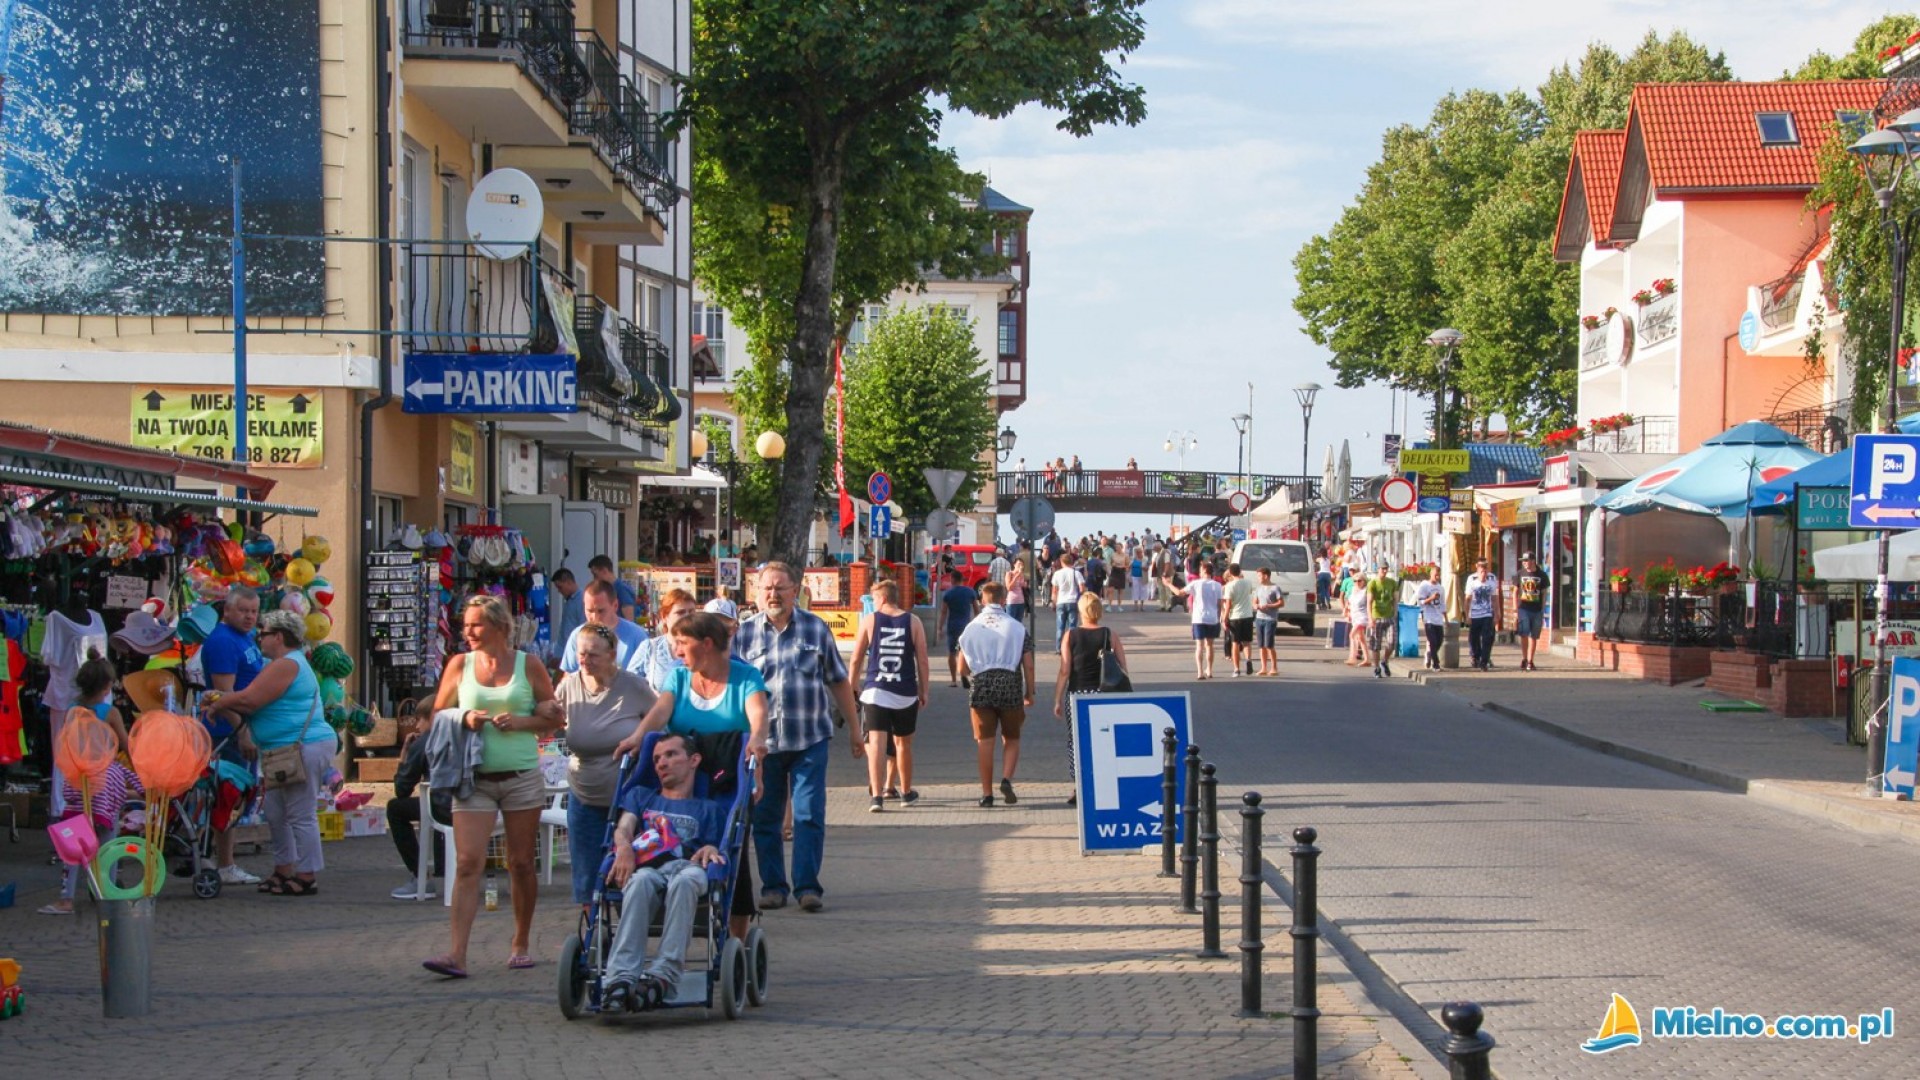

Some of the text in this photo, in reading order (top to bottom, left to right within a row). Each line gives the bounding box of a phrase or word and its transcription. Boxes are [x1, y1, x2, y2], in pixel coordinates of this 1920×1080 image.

[443, 370, 577, 406] PARKING
[190, 393, 266, 412] MIEJCE
[137, 418, 318, 442] NA TWOJĄ EKLAMĘ
[270, 447, 302, 464] 827
[1402, 453, 1465, 465] DELIKATESY
[1869, 443, 1917, 500] P
[826, 621, 846, 629] UMA
[875, 626, 906, 683] NICE
[1088, 703, 1176, 811] P
[1097, 822, 1180, 838] WJAZ
